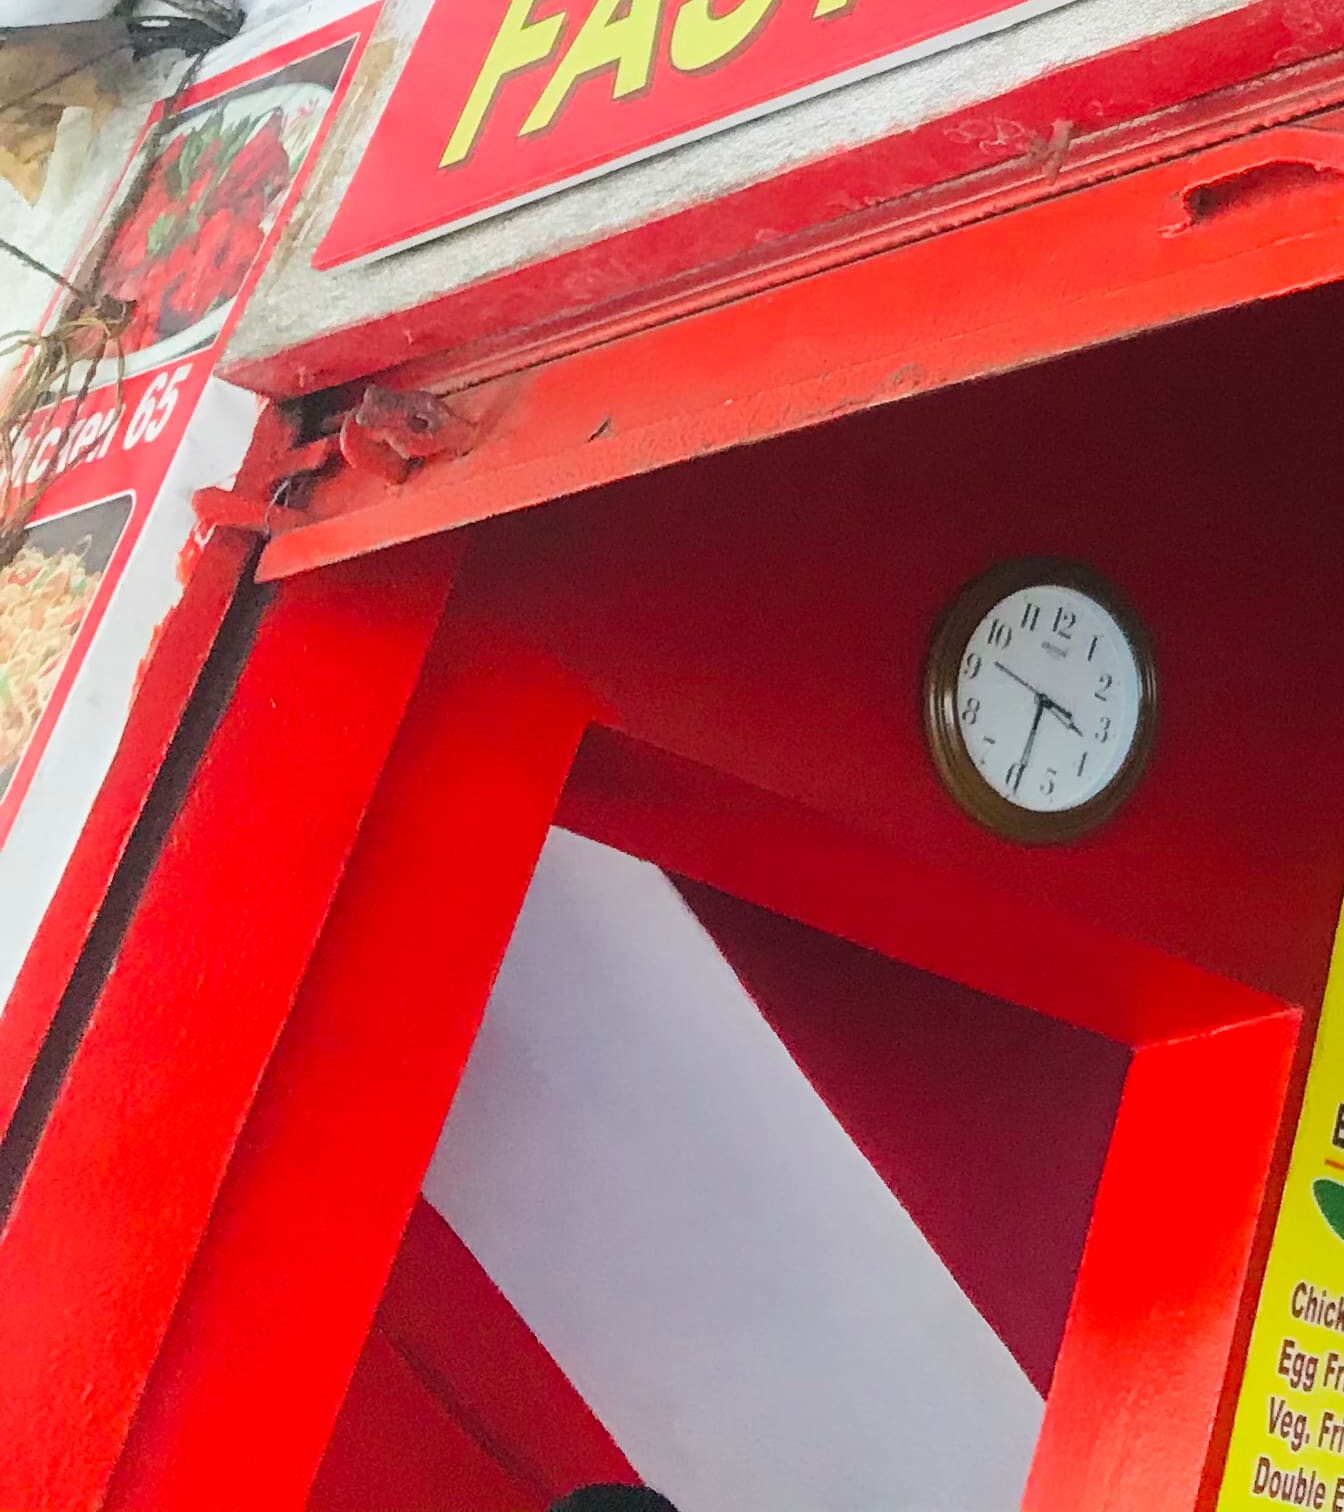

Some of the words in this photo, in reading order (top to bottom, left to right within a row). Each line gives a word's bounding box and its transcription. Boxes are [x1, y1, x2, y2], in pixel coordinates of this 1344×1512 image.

[123, 363, 193, 451] 65
[1021, 603, 1040, 631] 11
[1053, 607, 1076, 639] 12
[987, 619, 1012, 649] 10
[964, 653, 982, 679] 9
[1094, 674, 1112, 701] 2
[962, 697, 980, 725] 8
[1095, 716, 1111, 743] 3
[1278, 1339, 1319, 1392] Egg
[1268, 1396, 1311, 1451] Veg.
[1252, 1456, 1326, 1511] Double
